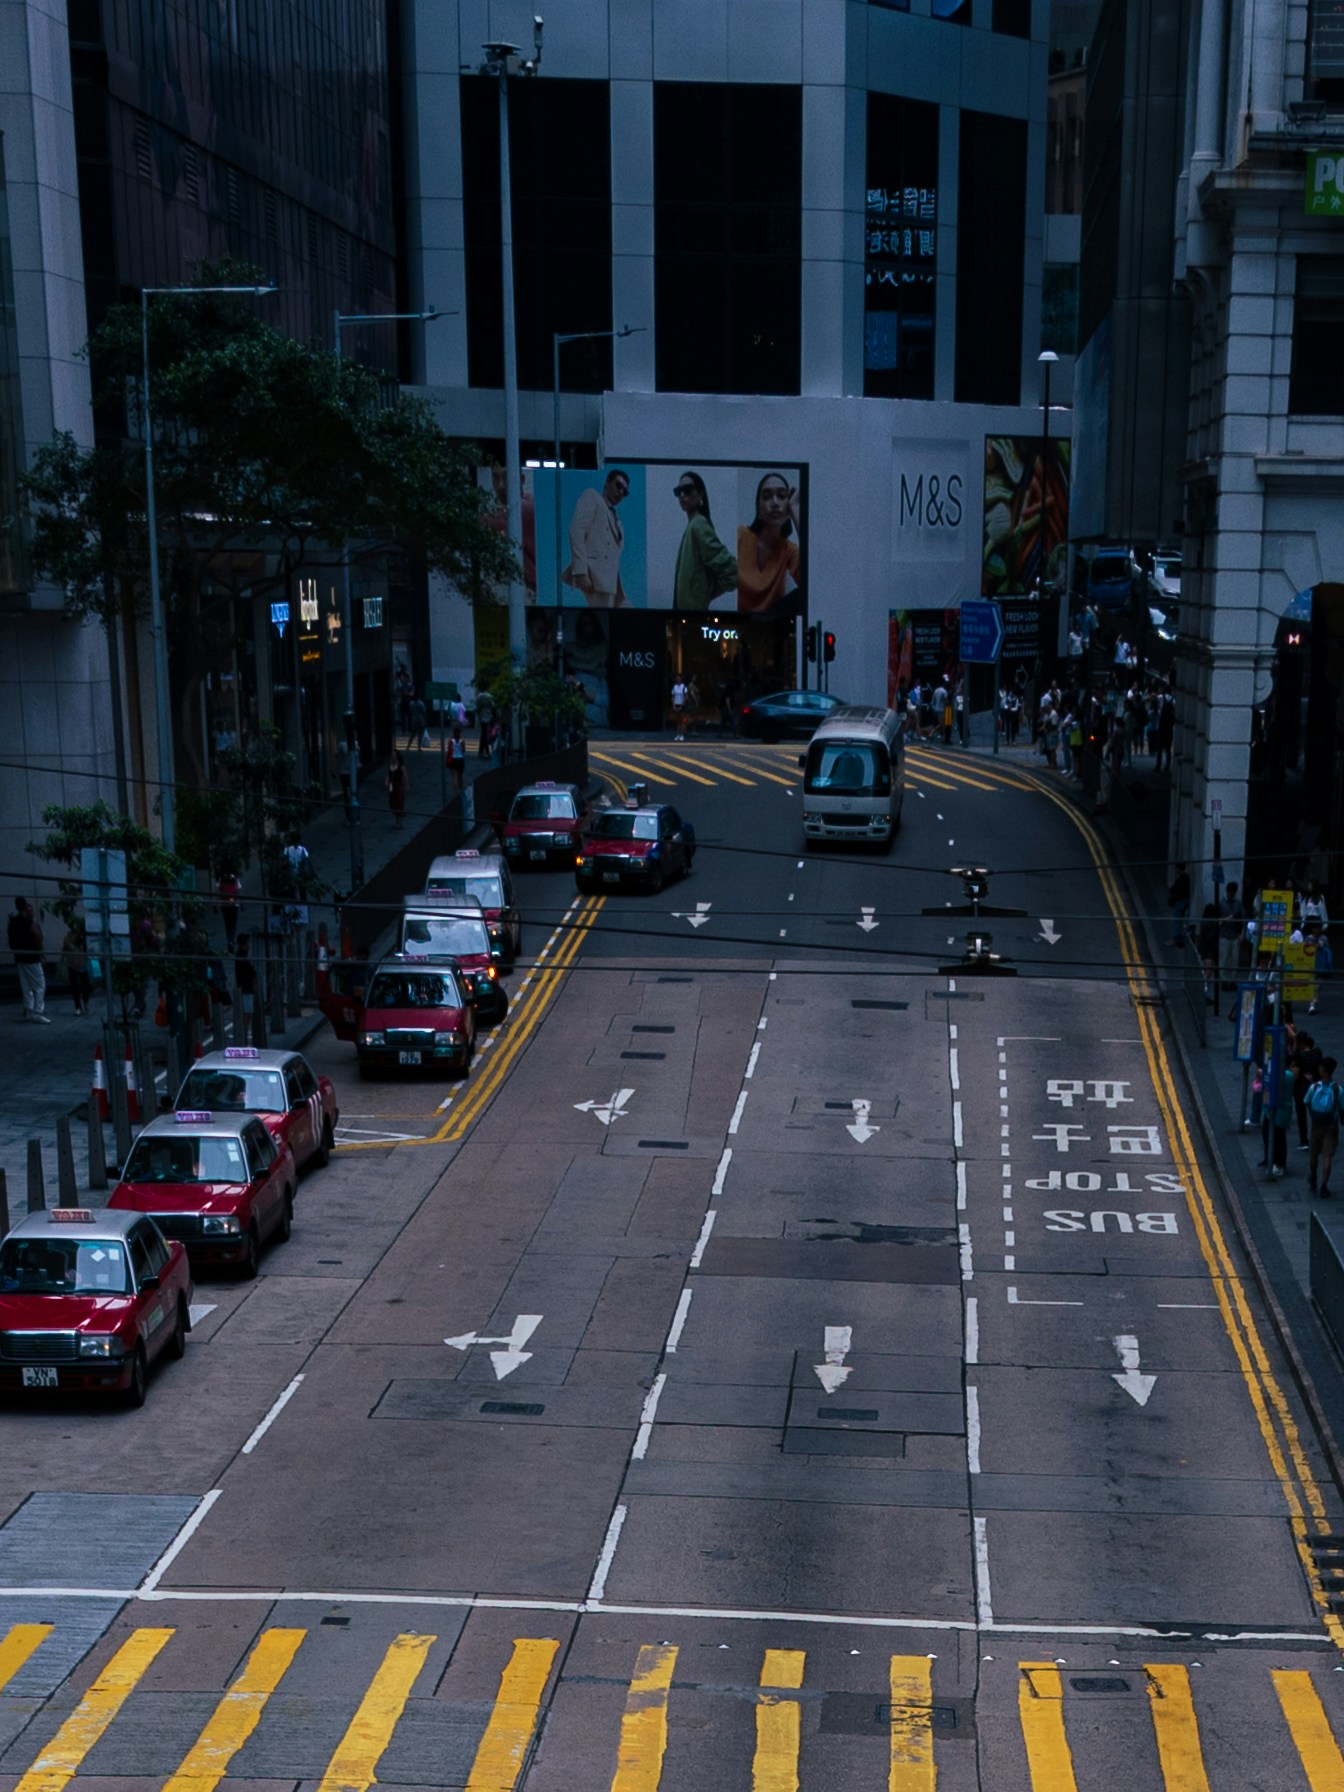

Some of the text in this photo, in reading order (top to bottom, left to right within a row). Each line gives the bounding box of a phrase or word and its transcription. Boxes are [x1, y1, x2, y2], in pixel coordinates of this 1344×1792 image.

[900, 474, 962, 527] M&S
[701, 626, 720, 642] Try
[619, 651, 655, 668] M&S
[1032, 1124, 1163, 1155] 巴士
[1025, 1171, 1188, 1193] STOP
[52, 1211, 90, 1220] TAXI
[1043, 1210, 1179, 1234] BUS
[34, 1367, 48, 1377] VN
